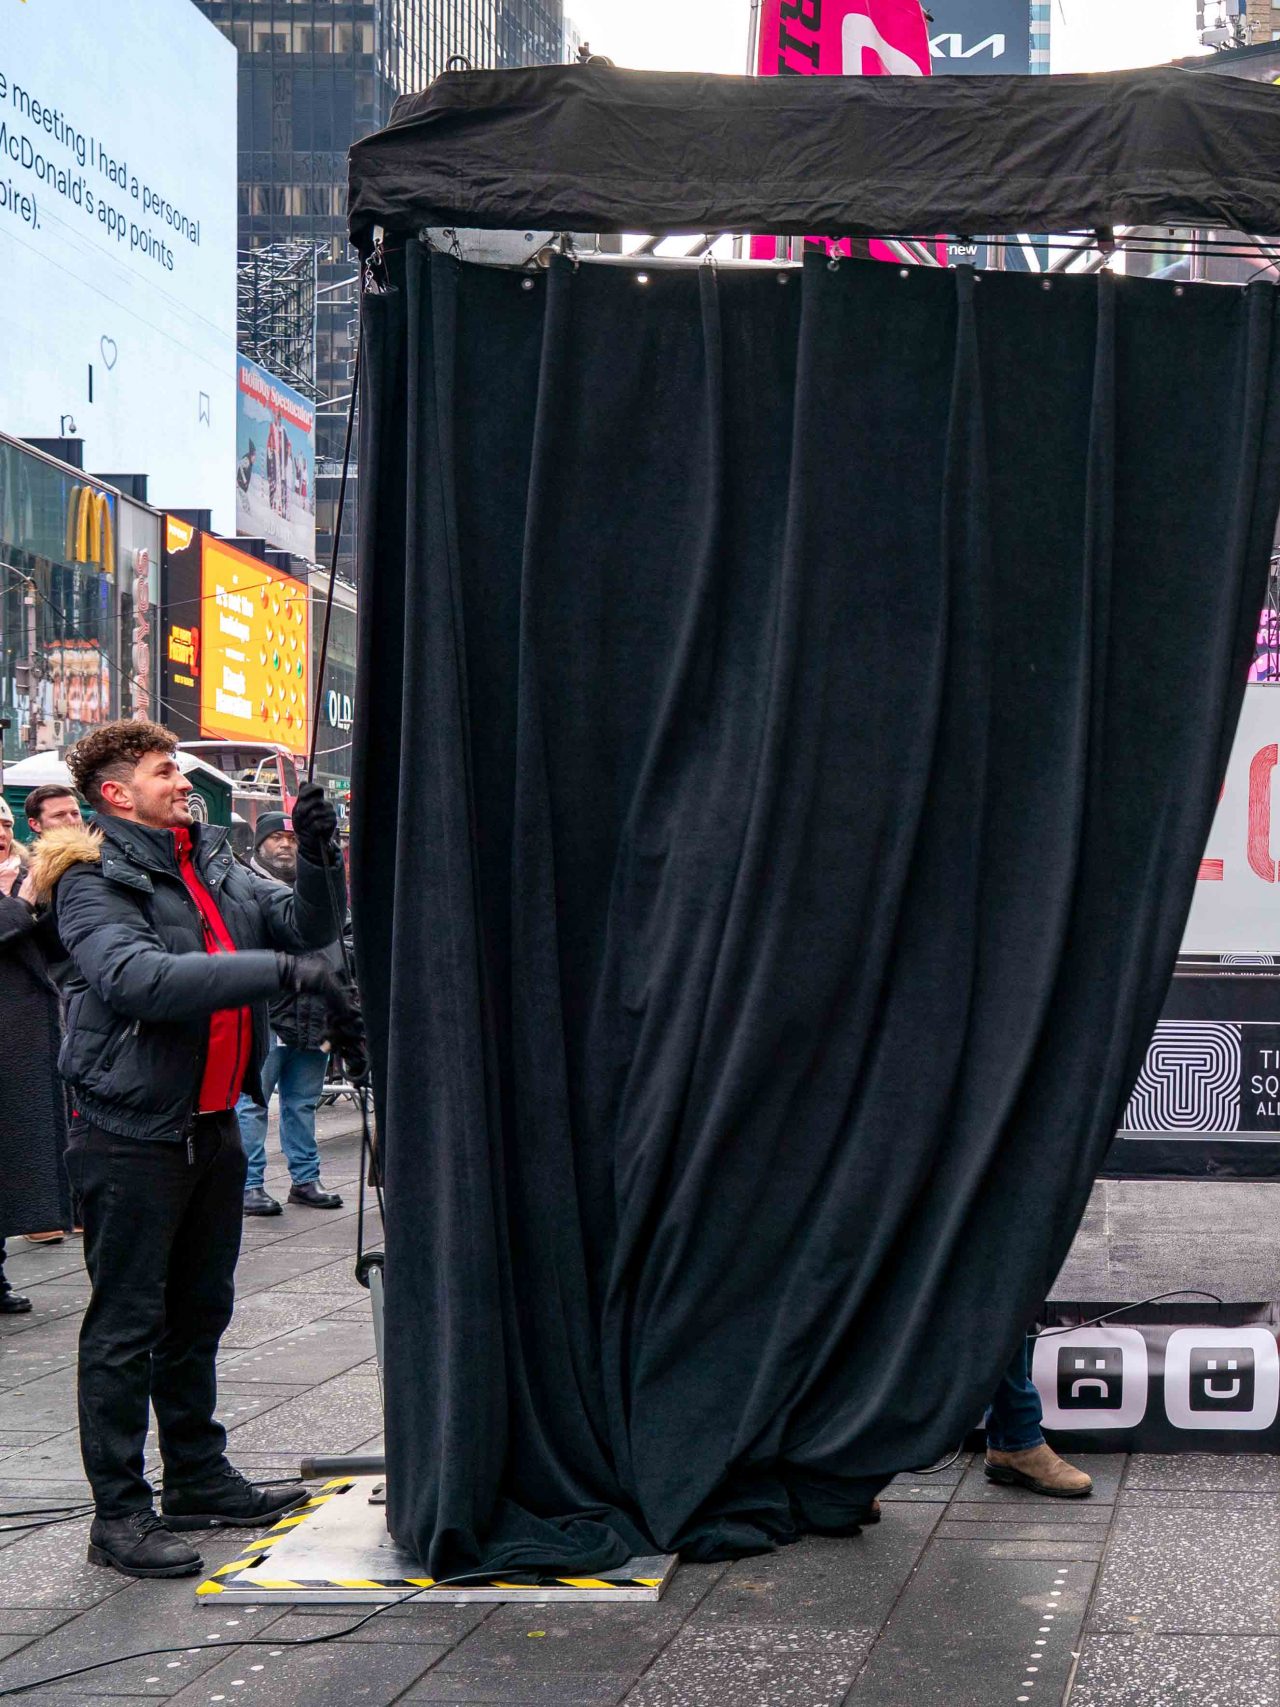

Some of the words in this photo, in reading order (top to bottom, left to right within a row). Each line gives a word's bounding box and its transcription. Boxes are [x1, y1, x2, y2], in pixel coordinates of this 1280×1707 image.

[13, 84, 86, 167] meeting
[91, 137, 94, 166] I
[99, 143, 127, 190] had
[131, 177, 139, 199] a
[143, 185, 200, 246] personal
[98, 200, 126, 241] app
[130, 222, 174, 271] points
[328, 690, 351, 731] OLD
